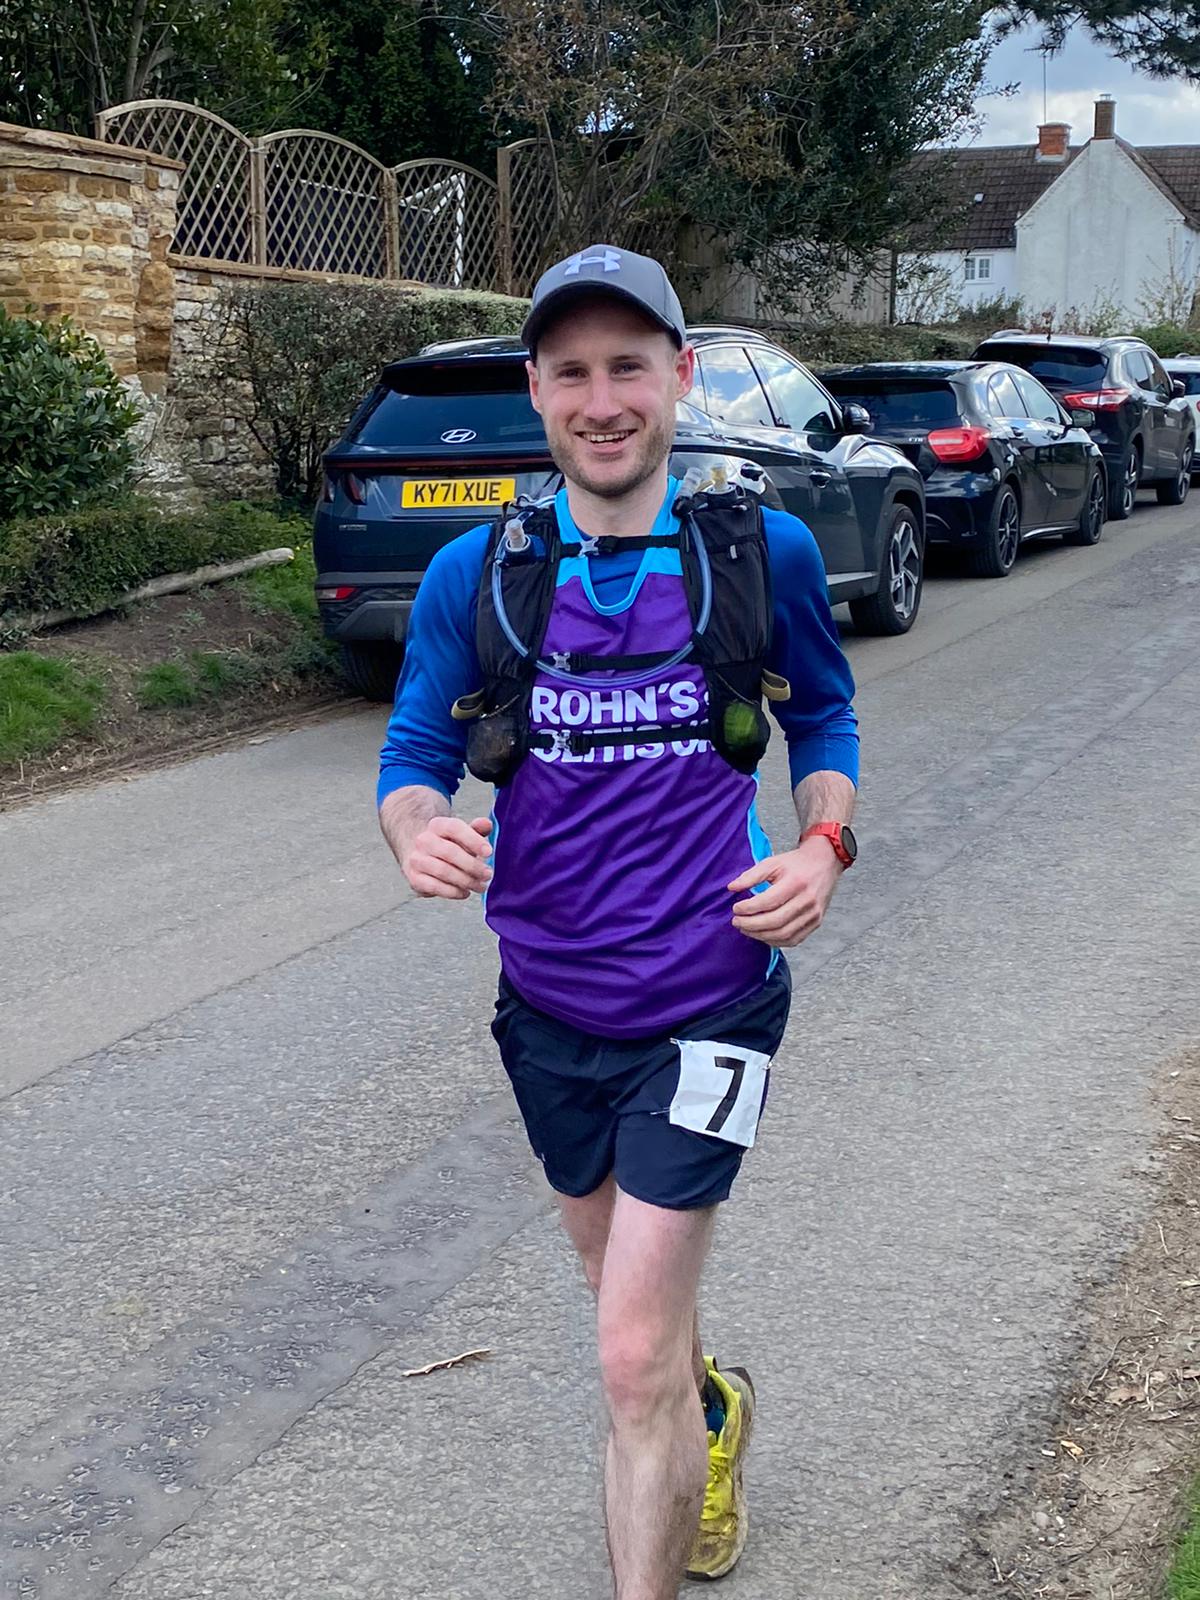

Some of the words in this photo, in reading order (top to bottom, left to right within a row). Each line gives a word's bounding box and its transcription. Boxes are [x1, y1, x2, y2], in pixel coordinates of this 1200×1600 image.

[414, 482, 457, 503] KY71
[462, 481, 502, 502] XUE
[529, 681, 699, 726] ROHN'S
[705, 1056, 747, 1133] 7
